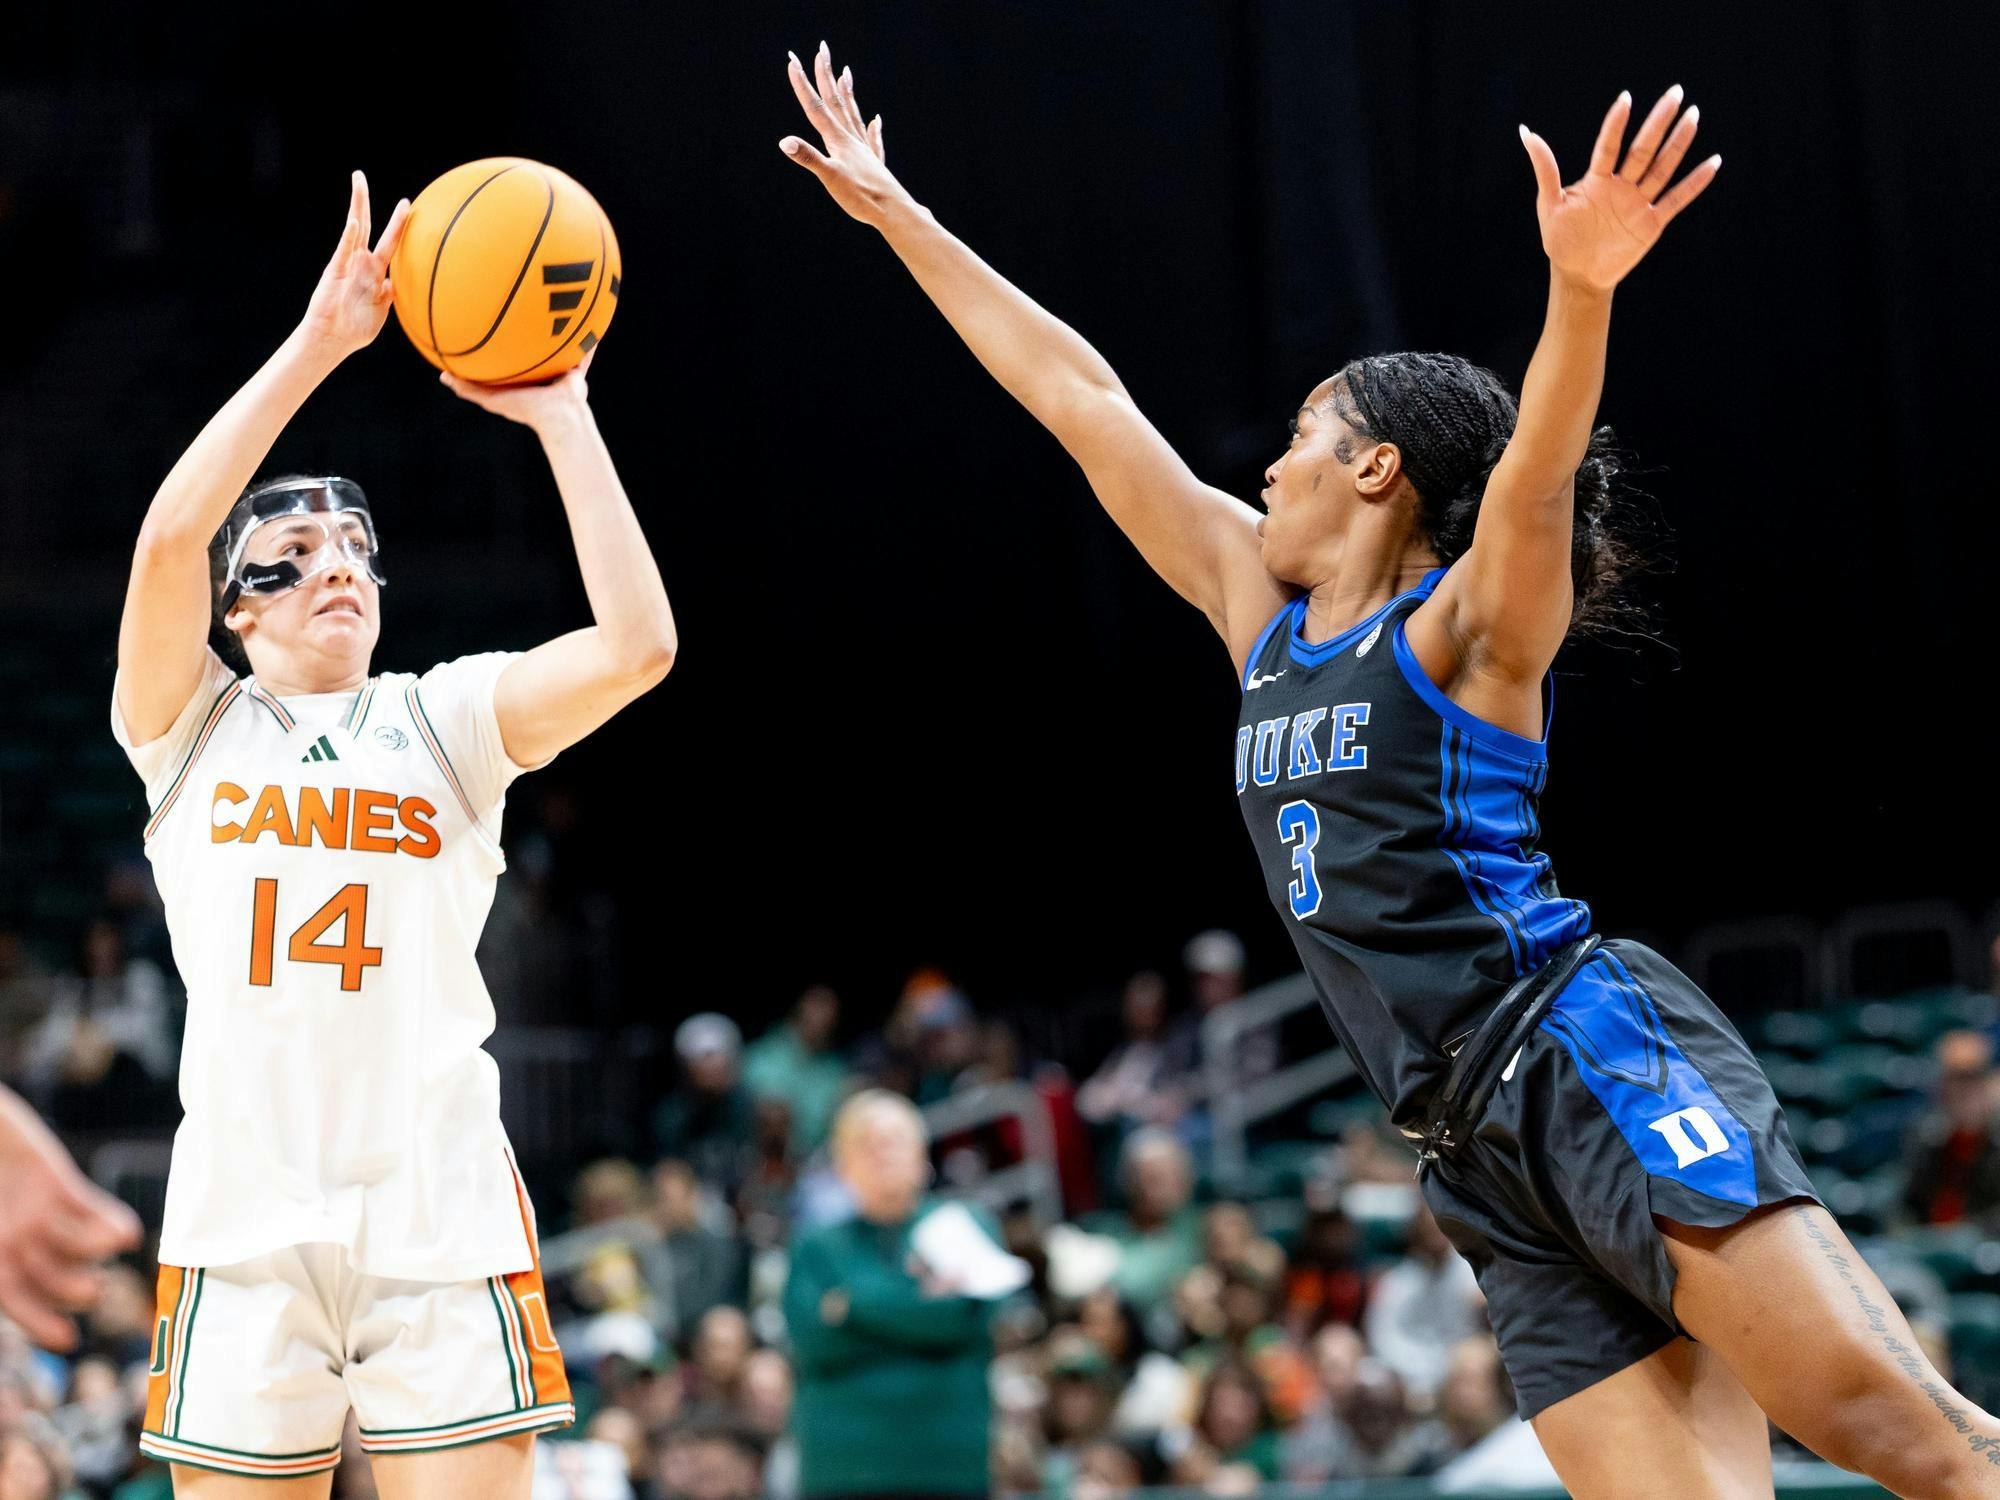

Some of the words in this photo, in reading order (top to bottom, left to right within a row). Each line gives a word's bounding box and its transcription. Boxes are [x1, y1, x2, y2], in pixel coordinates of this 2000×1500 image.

[1235, 702, 1371, 796] DUKE
[211, 781, 441, 859] CANES
[1277, 799, 1323, 921] 3
[249, 877, 383, 992] 14
[1647, 1106, 1730, 1170] D
